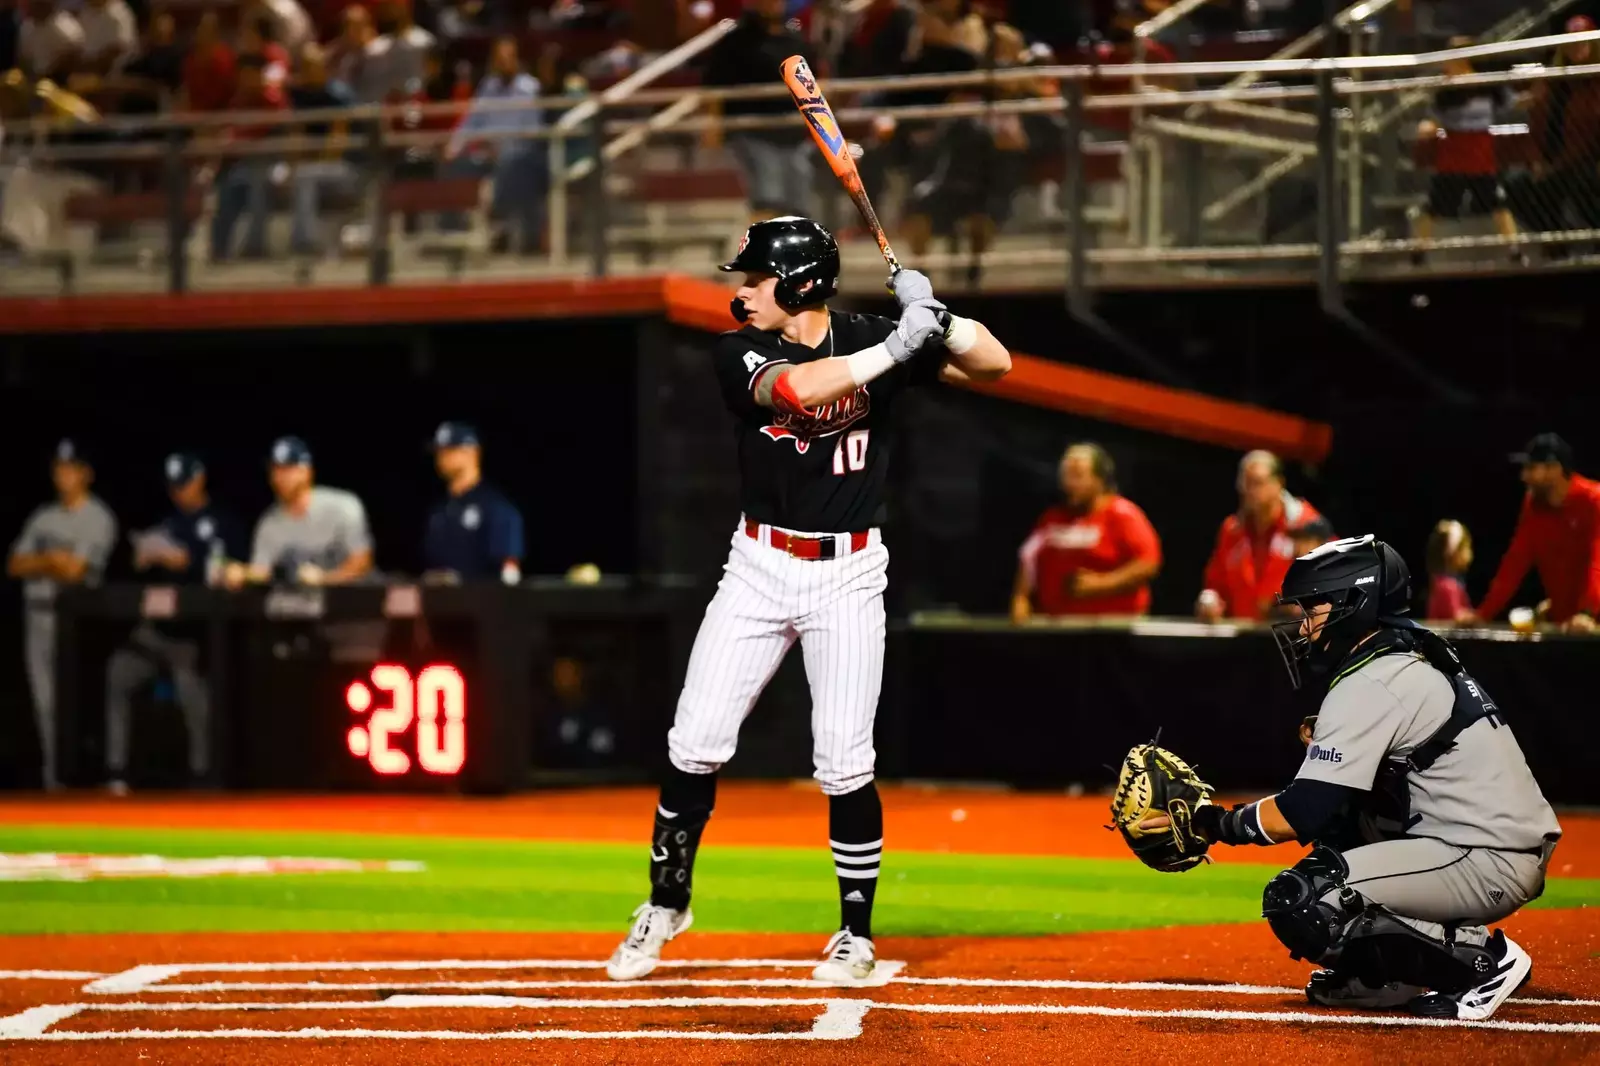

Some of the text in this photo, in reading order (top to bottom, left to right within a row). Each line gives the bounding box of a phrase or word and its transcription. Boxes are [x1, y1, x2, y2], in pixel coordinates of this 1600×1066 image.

[742, 350, 767, 372] A
[832, 429, 870, 475] 10
[346, 664, 466, 774] :20
[1310, 744, 1344, 763] Owls
